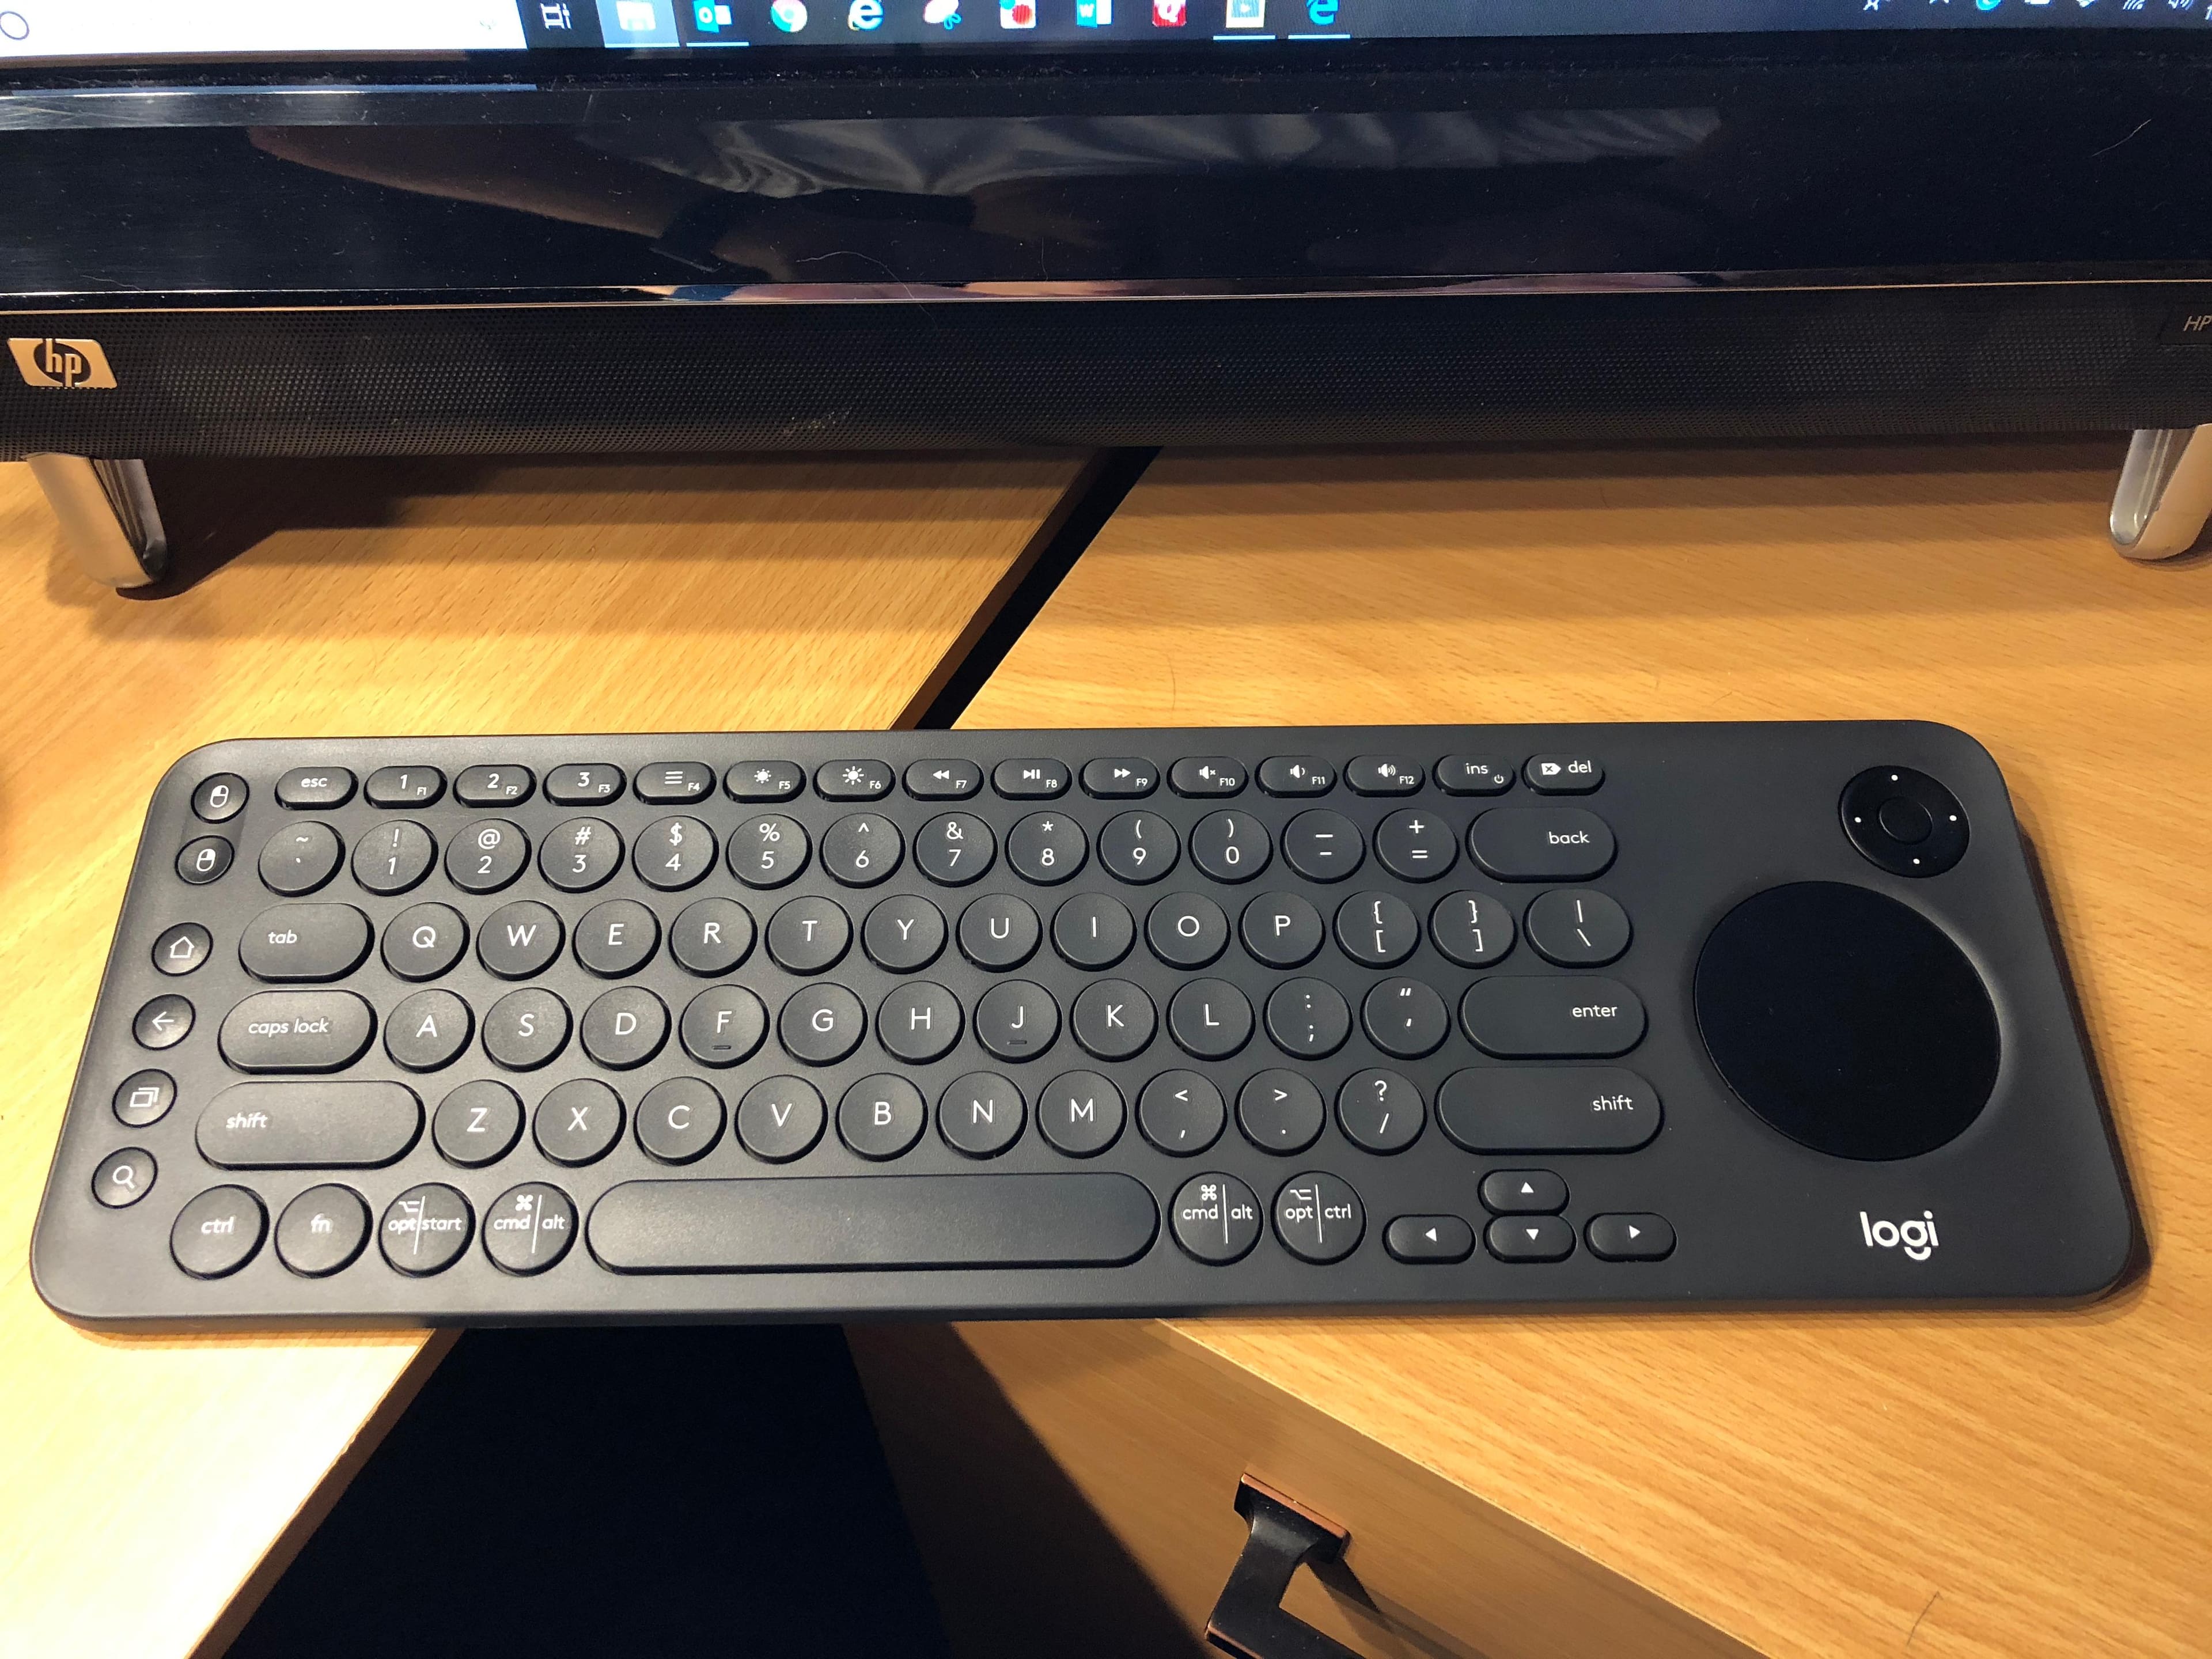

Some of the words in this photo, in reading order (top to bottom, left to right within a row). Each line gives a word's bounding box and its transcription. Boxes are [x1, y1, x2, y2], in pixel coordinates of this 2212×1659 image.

[2183, 315, 2212, 331] HP
[45, 338, 82, 388] hp
[1466, 765, 1488, 774] ins
[1568, 760, 1592, 773] del
[301, 778, 328, 788] esc
[400, 774, 408, 789] 1
[487, 773, 499, 789] 2
[577, 772, 590, 787] 3
[598, 784, 611, 793] F3
[688, 782, 700, 791] F4
[779, 781, 790, 790] F5
[869, 780, 881, 789] F6
[956, 780, 967, 789] F7
[1046, 779, 1058, 788] F8
[1136, 778, 1148, 786] F9
[1219, 778, 1236, 786] F10
[1312, 776, 1325, 785] F11
[1399, 775, 1414, 785] F12
[416, 787, 427, 796] F1
[506, 786, 518, 795] F2
[575, 826, 592, 845] #
[669, 822, 683, 846] $
[759, 823, 780, 842] %
[946, 821, 964, 840] &
[1409, 820, 1425, 834] +
[392, 828, 399, 847] !
[478, 828, 501, 850] @
[1548, 831, 1590, 844] back
[478, 855, 492, 874] 2
[572, 854, 586, 873] 3
[665, 853, 681, 871] 4
[761, 851, 774, 869] 5
[855, 850, 869, 868] 6
[949, 849, 961, 866] 7
[1041, 848, 1055, 866] 8
[1132, 847, 1146, 865] 9
[1226, 846, 1240, 864] 0
[388, 857, 396, 875] 1
[608, 923, 624, 945] E
[703, 922, 721, 944] R
[802, 920, 818, 941] T
[897, 919, 914, 940] Y
[991, 918, 1009, 939] U
[1092, 916, 1096, 937] I
[1177, 915, 1200, 937] O
[1275, 915, 1291, 936] P
[268, 929, 297, 944] tab
[412, 926, 436, 948] Q
[507, 925, 536, 946] W
[812, 1009, 834, 1032] G
[911, 1007, 931, 1030] H
[1011, 1006, 1024, 1029] J
[1107, 1005, 1124, 1027] K
[1205, 1003, 1219, 1026] L
[1572, 1005, 1618, 1017] enter
[248, 1022, 289, 1037] caps
[294, 1018, 329, 1033] lock
[416, 1014, 437, 1037] A
[518, 1013, 535, 1037] S
[615, 1012, 637, 1035] D
[717, 1010, 732, 1033] F
[1374, 1080, 1387, 1101] ?
[973, 1099, 993, 1123] N
[1071, 1098, 1093, 1122] M
[1593, 1094, 1634, 1111] shift
[226, 1112, 268, 1129] shift
[467, 1107, 488, 1132] Z
[567, 1107, 588, 1131] X
[668, 1105, 690, 1130] C
[771, 1103, 792, 1127] V
[874, 1101, 892, 1125] B
[1182, 1204, 1218, 1220] cmd
[1231, 1204, 1253, 1219] alt
[1285, 1206, 1313, 1223] opt
[1324, 1203, 1351, 1219] ctrl
[201, 1216, 234, 1234] ctrl
[310, 1214, 331, 1233] fn
[388, 1217, 418, 1236] opt
[421, 1218, 462, 1230] start
[494, 1214, 531, 1230] cmd
[541, 1214, 565, 1230] alt
[1859, 1210, 1939, 1260] logi
